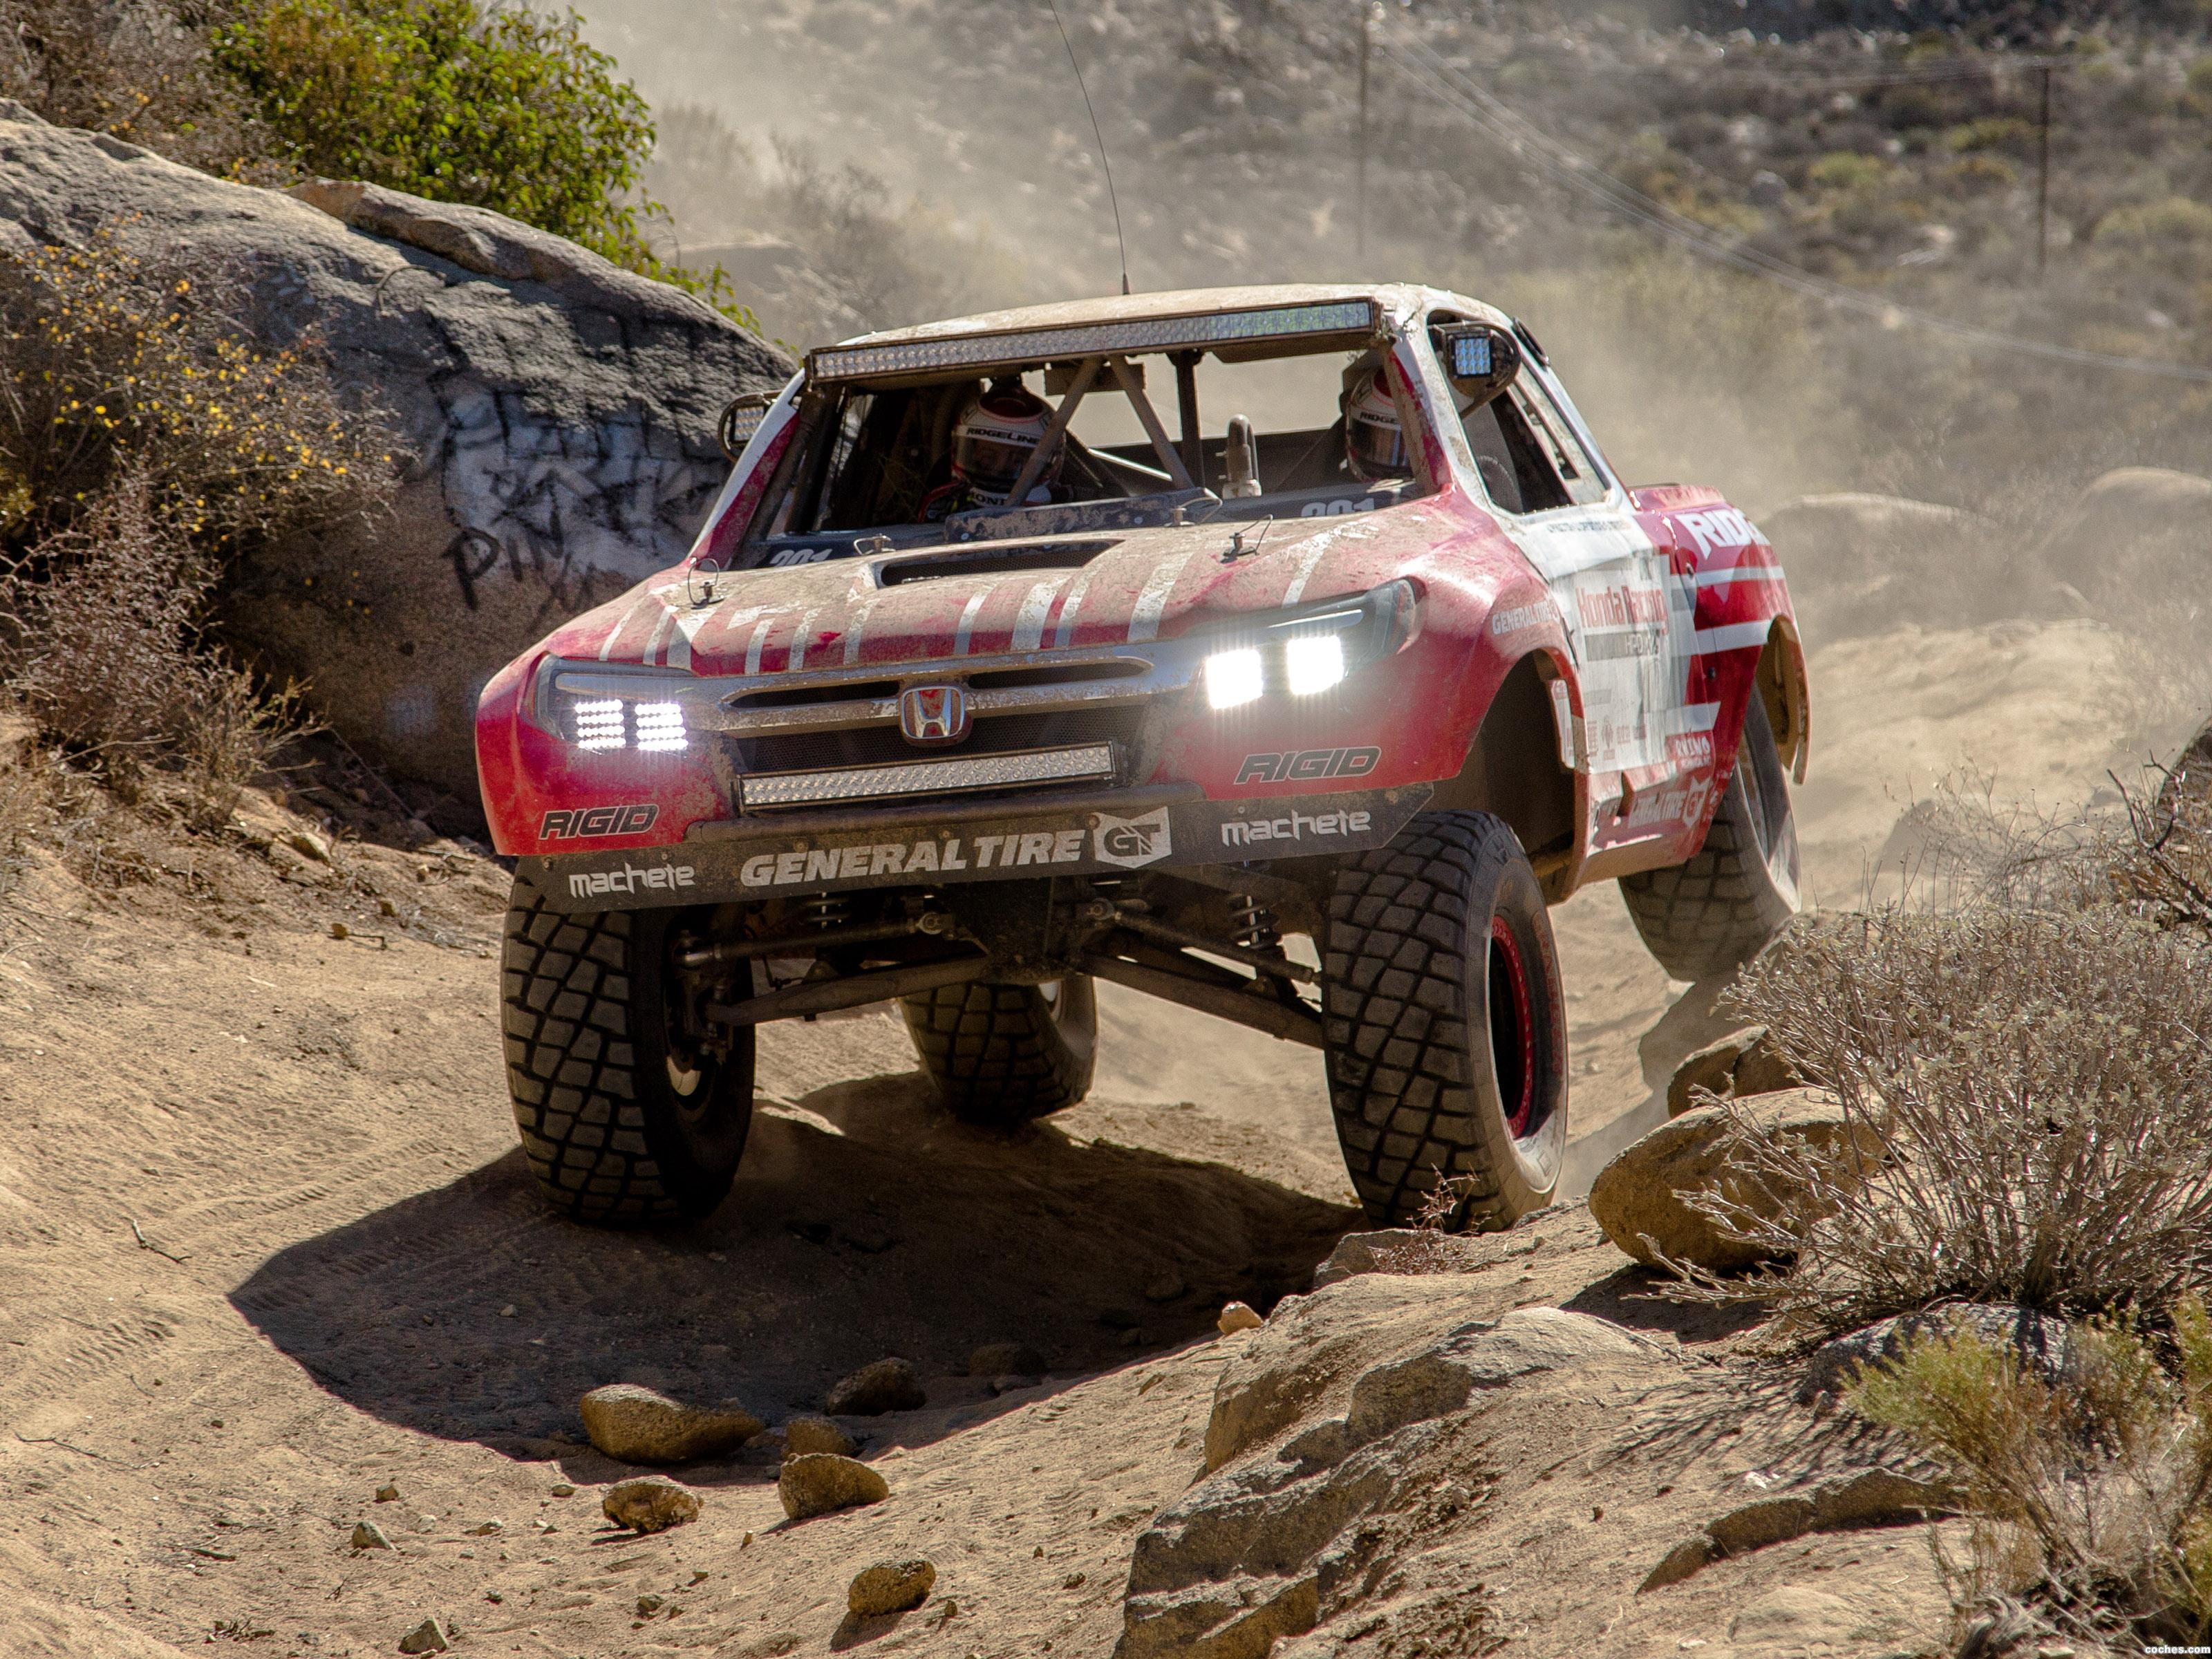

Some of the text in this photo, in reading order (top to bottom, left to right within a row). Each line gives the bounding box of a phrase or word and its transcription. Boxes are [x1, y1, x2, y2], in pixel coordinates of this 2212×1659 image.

[1492, 605, 1538, 635] GENERAL
[1575, 585, 1624, 628] Honda
[1233, 745, 1382, 785] RIGID
[538, 803, 660, 841] RIGID
[1221, 809, 1373, 847] machete
[739, 838, 968, 888] GENERAL
[973, 829, 1087, 869] TIRE
[568, 861, 697, 899] machete
